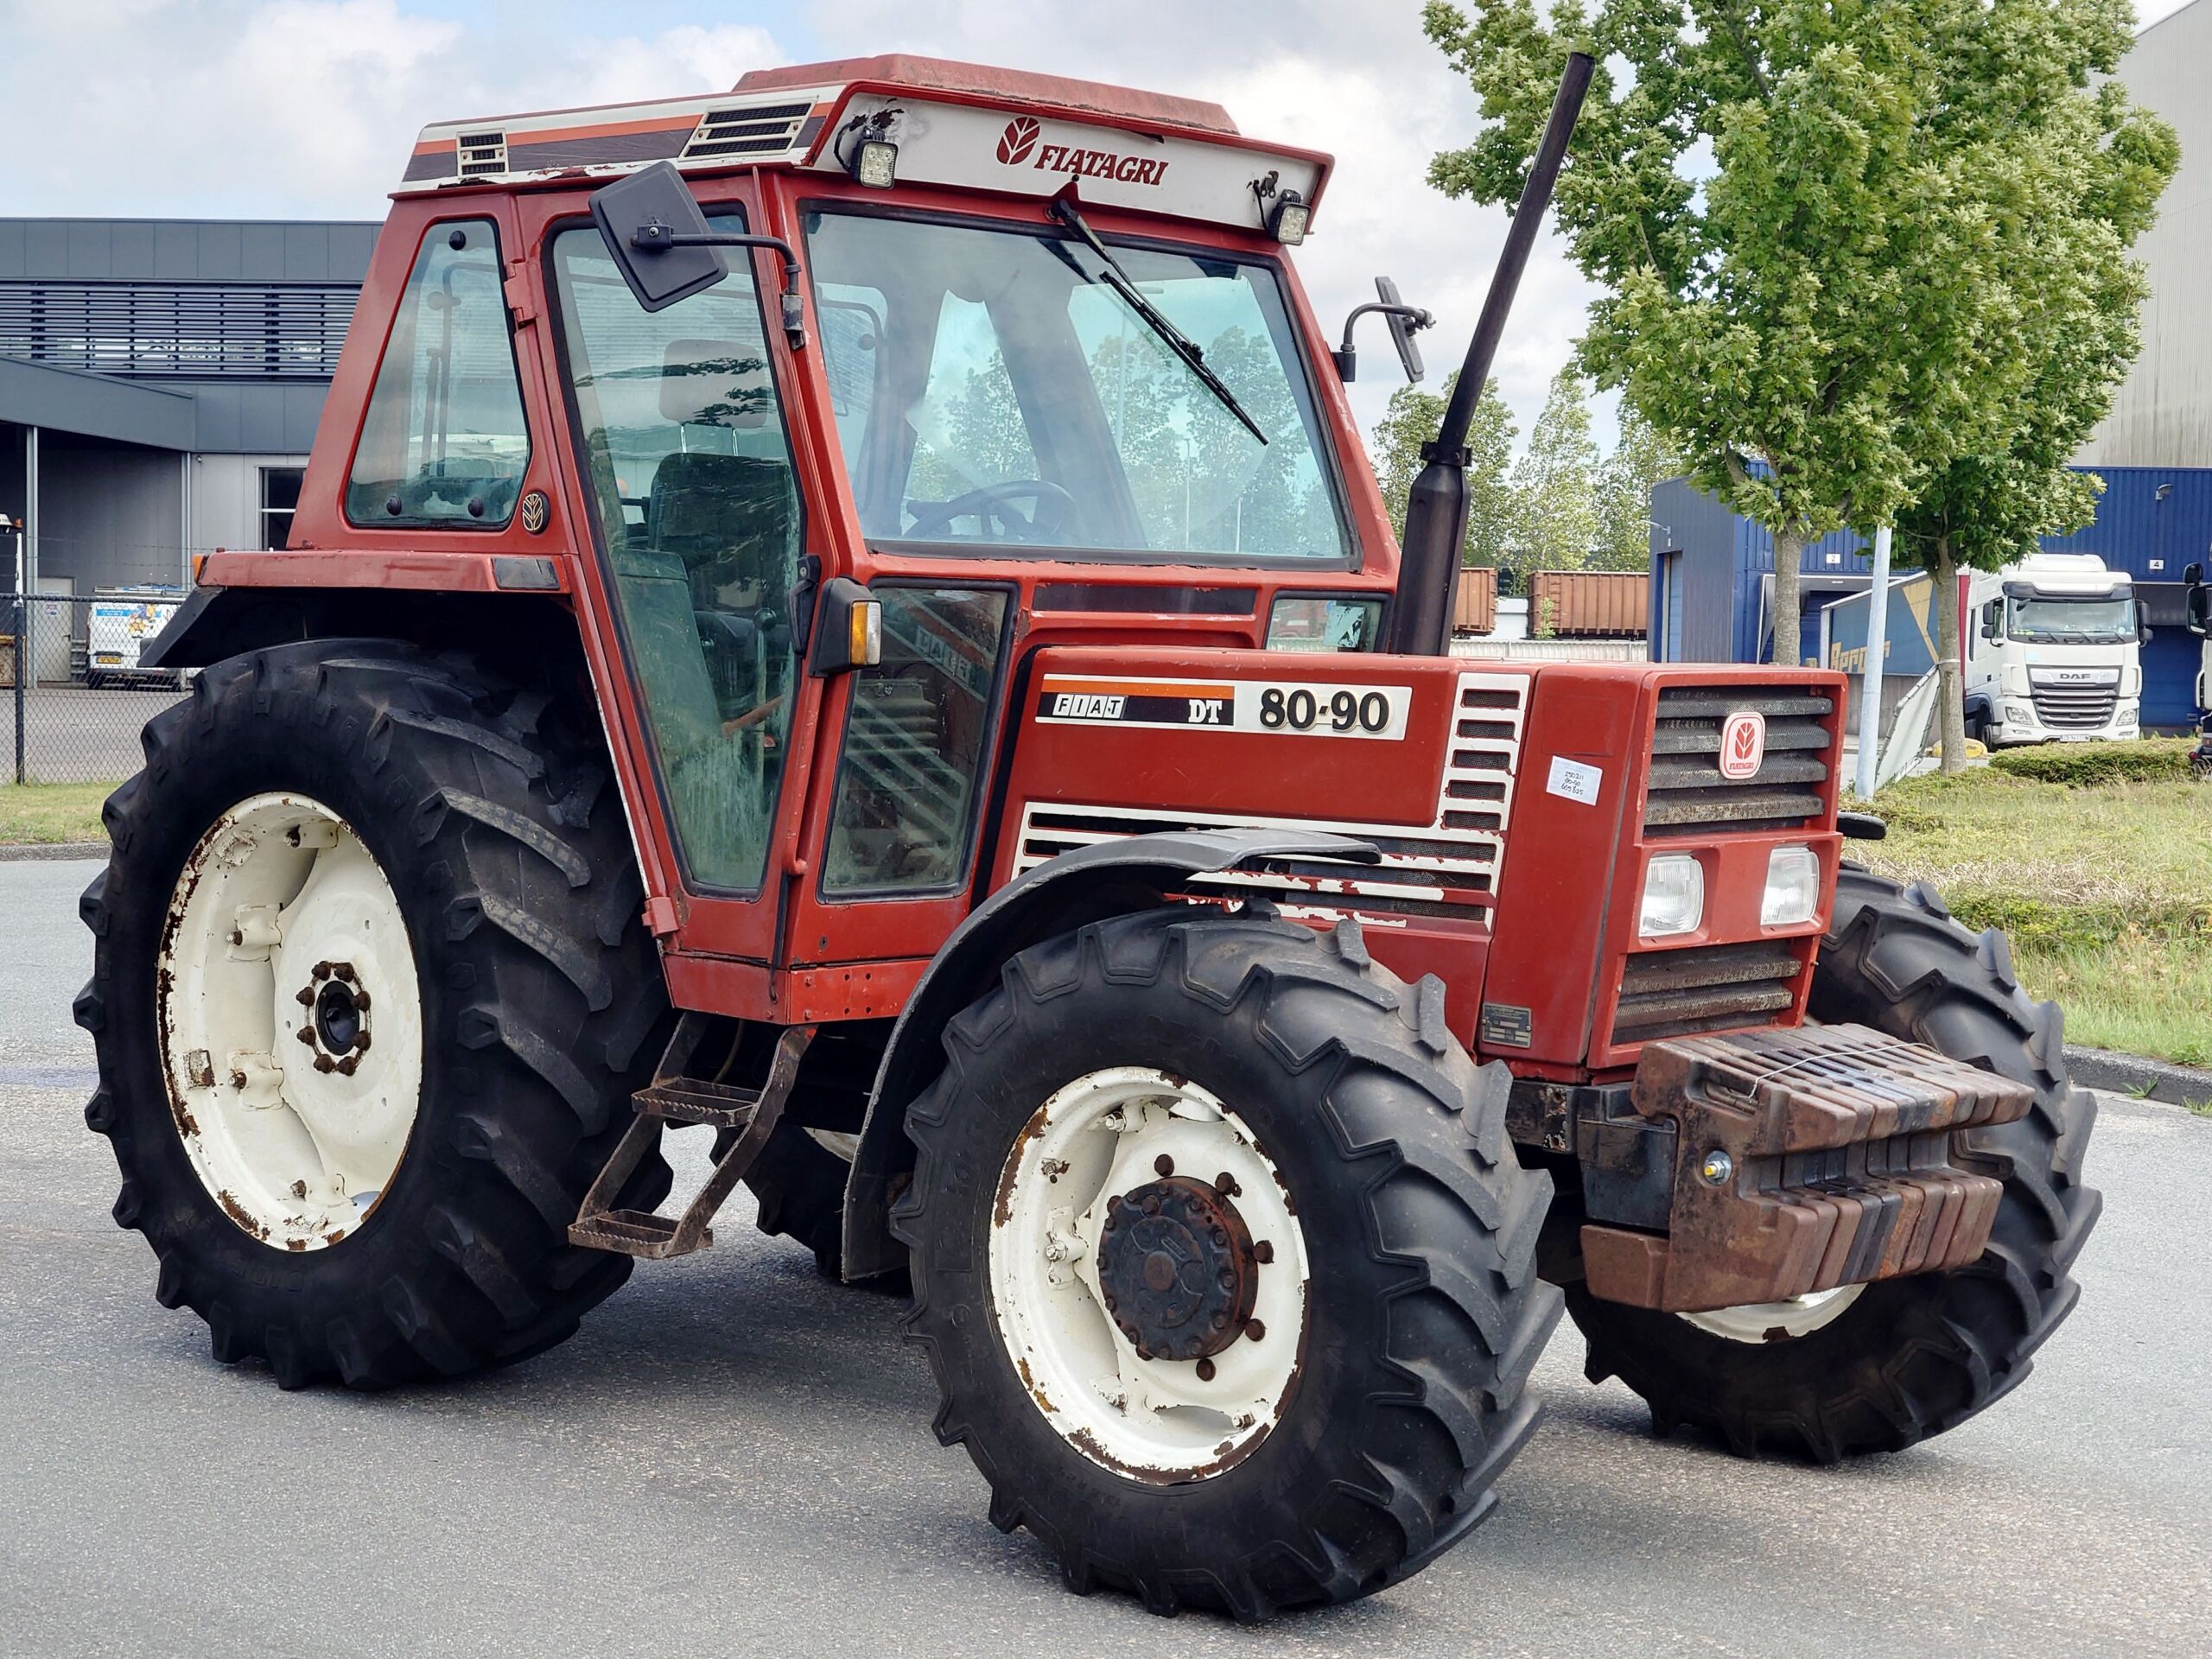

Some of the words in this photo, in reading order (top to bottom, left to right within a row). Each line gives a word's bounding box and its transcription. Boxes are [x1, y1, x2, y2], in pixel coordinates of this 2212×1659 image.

[1033, 144, 1169, 186] FIATAGRI
[1057, 696, 1122, 716] FIAT
[1188, 699, 1223, 724] DT
[1259, 688, 1391, 733] 80-90
